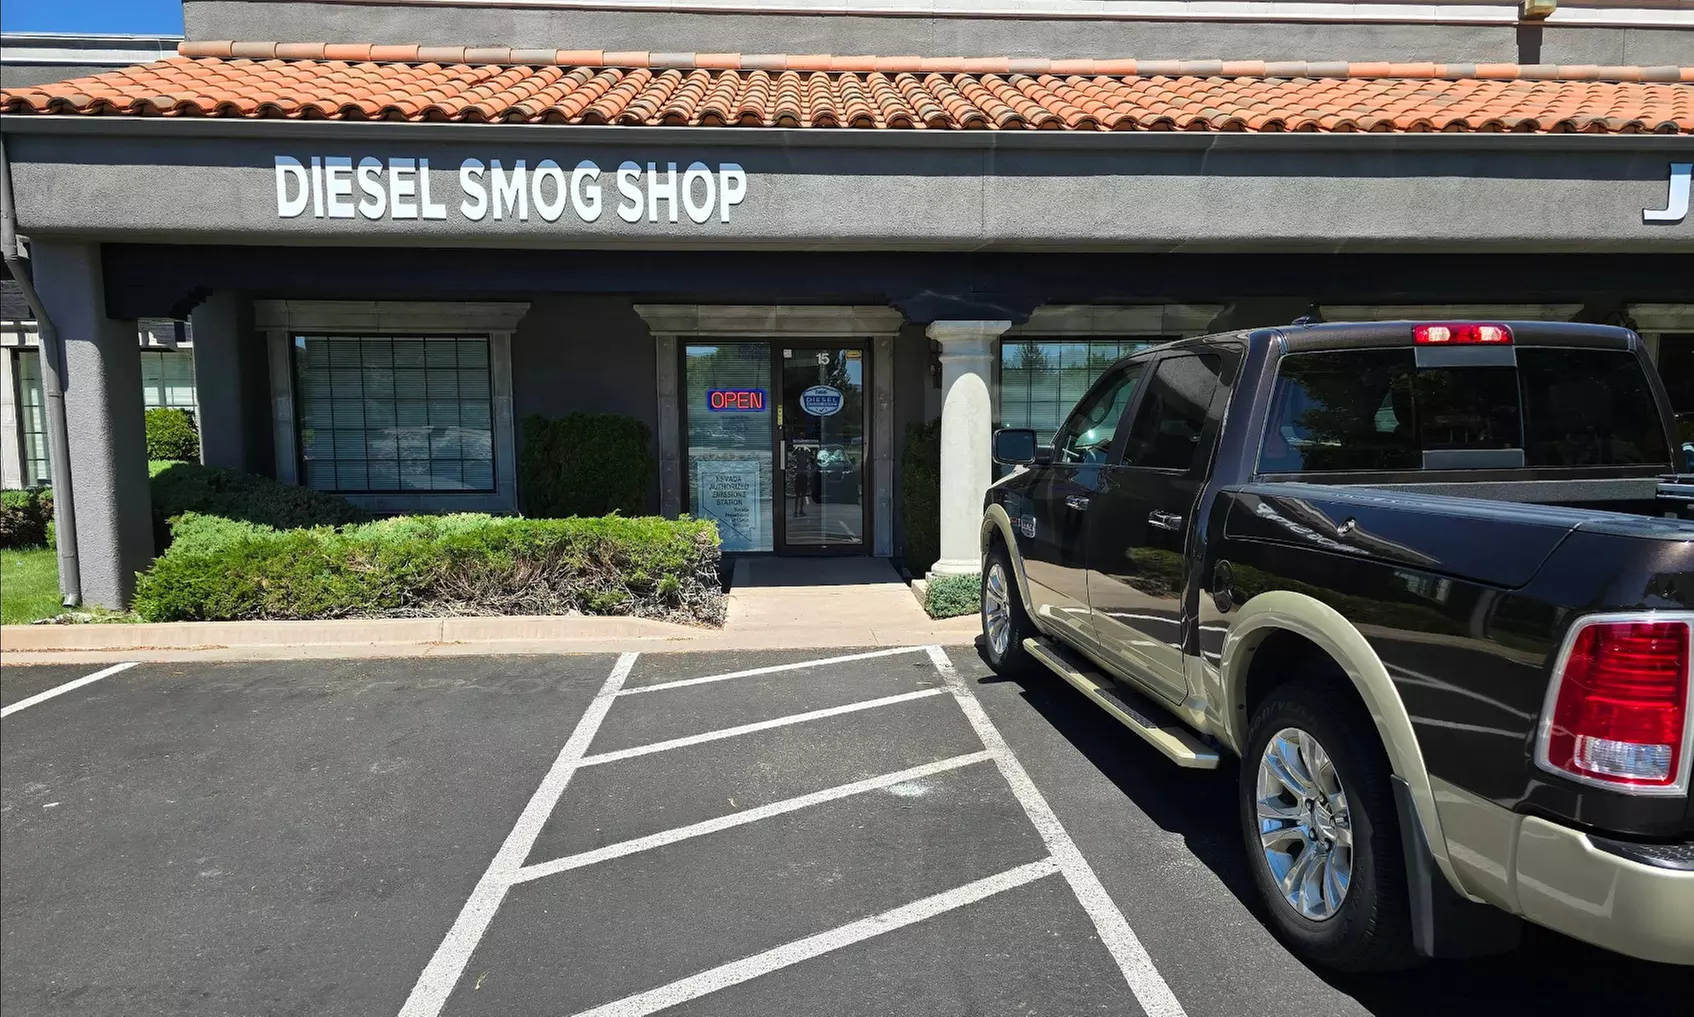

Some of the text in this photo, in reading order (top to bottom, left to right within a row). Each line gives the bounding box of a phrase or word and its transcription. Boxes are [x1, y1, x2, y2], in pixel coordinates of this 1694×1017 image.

[275, 155, 747, 223] DIESEL SMOG SHOP
[816, 352, 830, 365] 15
[710, 391, 763, 410] OPEN
[709, 483, 750, 491] AUTHORIZED
[712, 491, 747, 499] EMISSIONS
